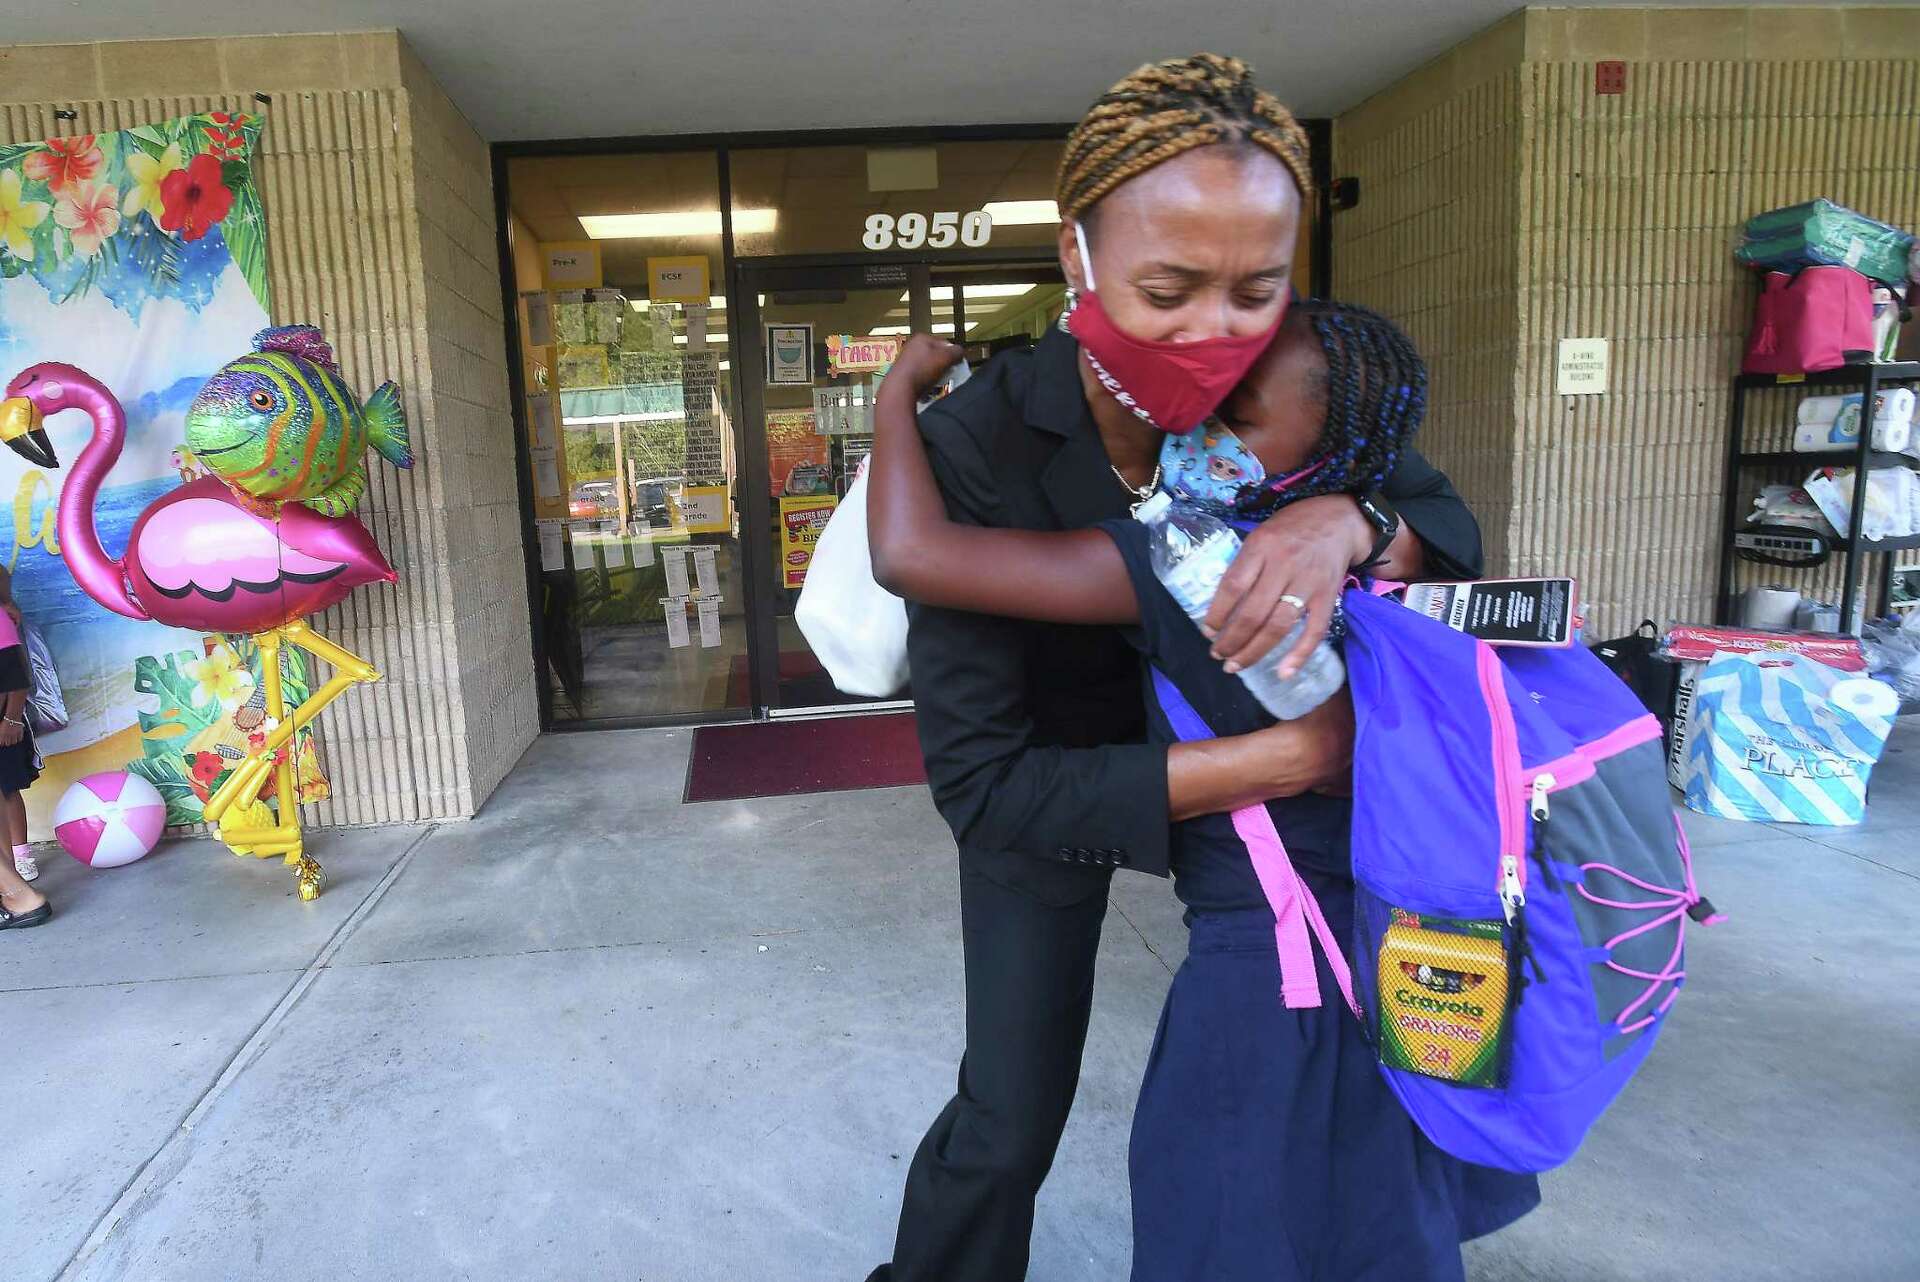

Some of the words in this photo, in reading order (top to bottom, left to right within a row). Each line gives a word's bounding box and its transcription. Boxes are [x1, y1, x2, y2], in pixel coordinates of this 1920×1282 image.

[862, 210, 992, 250] 8950
[839, 344, 895, 364] PARTY
[819, 392, 868, 410] Buidig
[1671, 677, 1694, 775] Marshalls
[1742, 748, 1860, 780] PLACE
[1396, 988, 1484, 1017] Crayola
[1400, 1014, 1482, 1043] CRAYONS
[1423, 1042, 1451, 1067] 24
